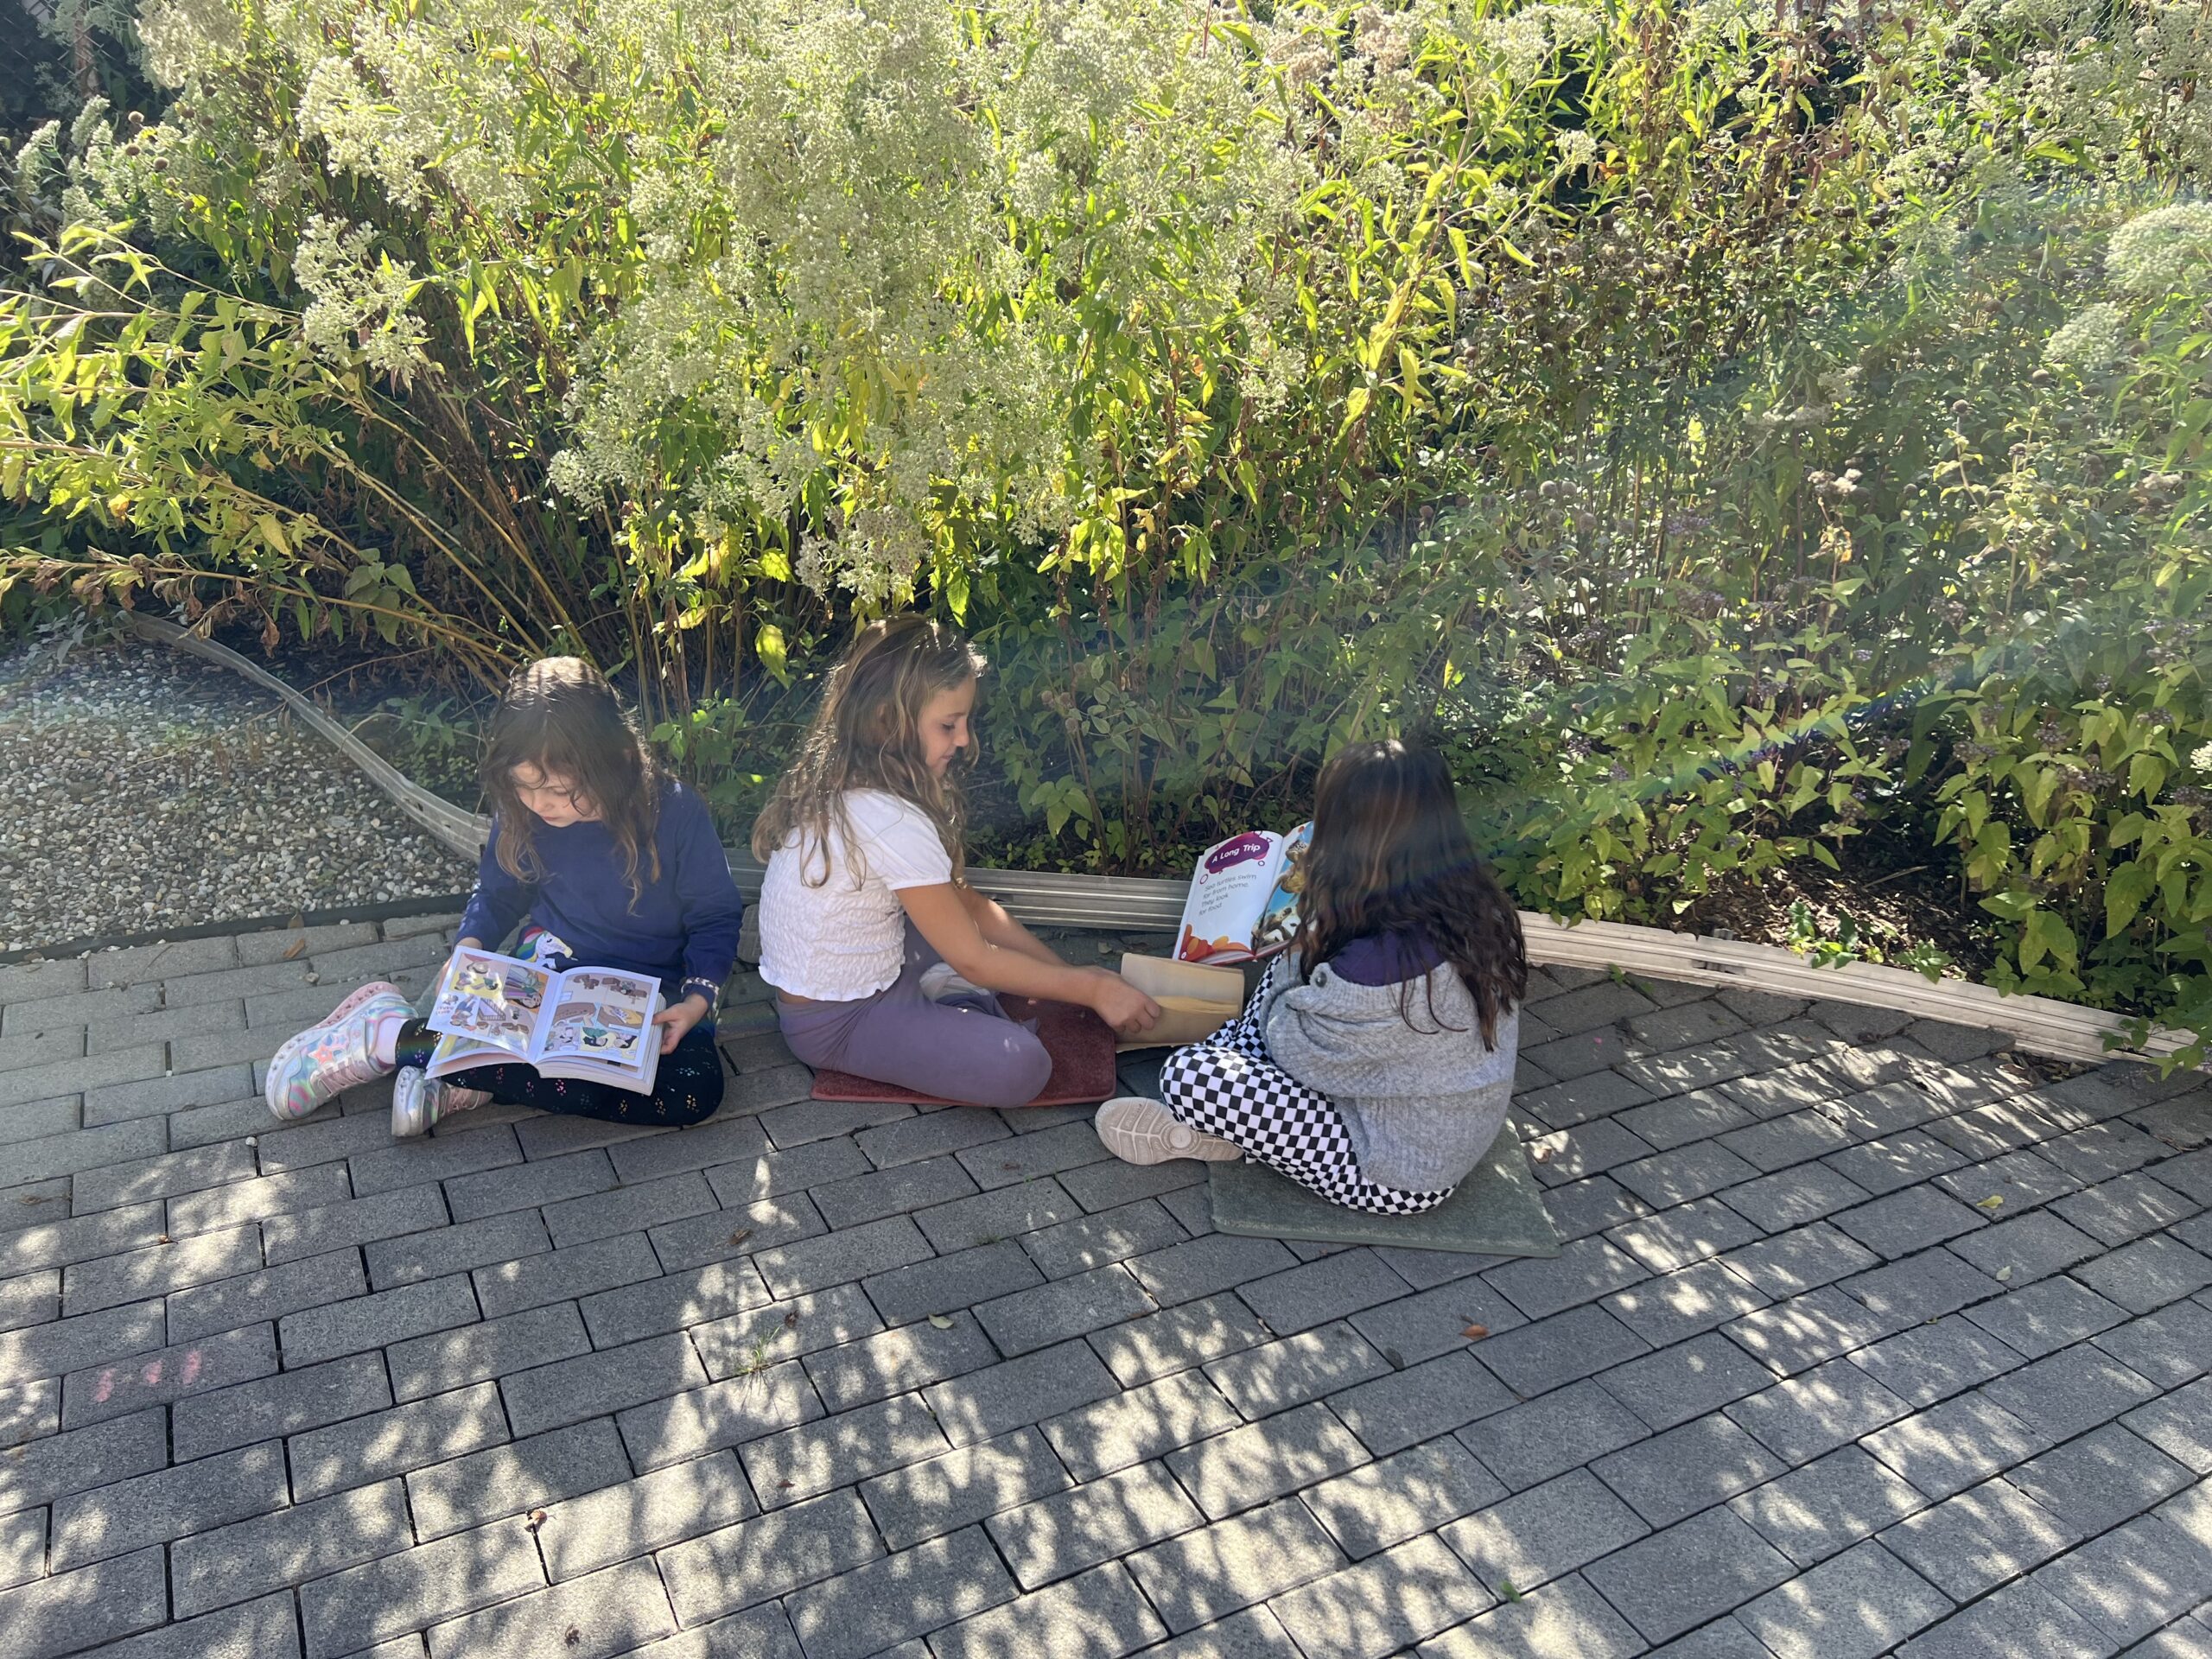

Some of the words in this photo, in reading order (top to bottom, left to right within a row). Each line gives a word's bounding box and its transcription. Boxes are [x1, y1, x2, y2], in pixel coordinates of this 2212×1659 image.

[1219, 848, 1240, 860] Long
[1243, 843, 1261, 852] Trip
[1217, 876, 1236, 886] turtles
[1212, 887, 1227, 895] from
